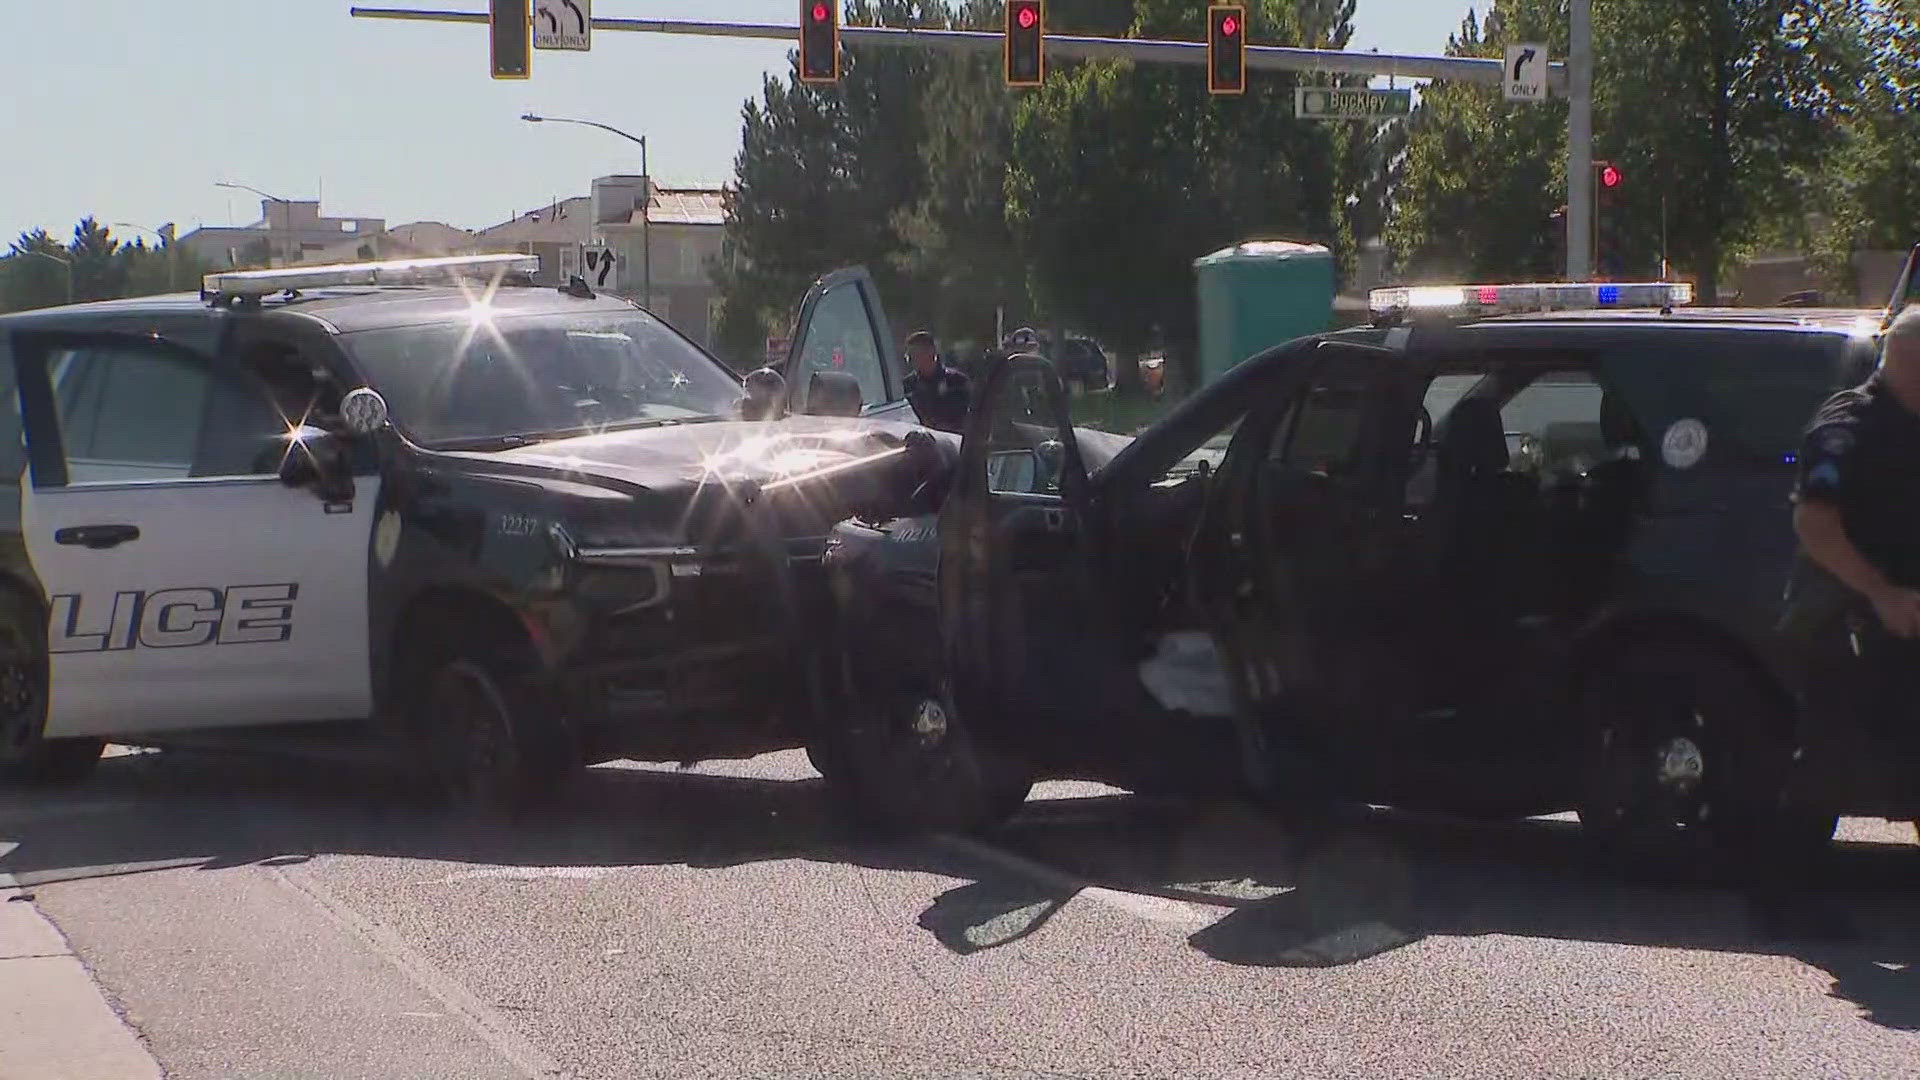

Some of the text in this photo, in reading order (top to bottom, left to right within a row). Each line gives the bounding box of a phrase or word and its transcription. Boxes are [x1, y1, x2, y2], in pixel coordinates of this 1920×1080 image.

[536, 34, 559, 45] ONLY
[562, 35, 587, 46] ONLY
[1511, 83, 1538, 96] ONLY
[1330, 91, 1387, 113] Buckley
